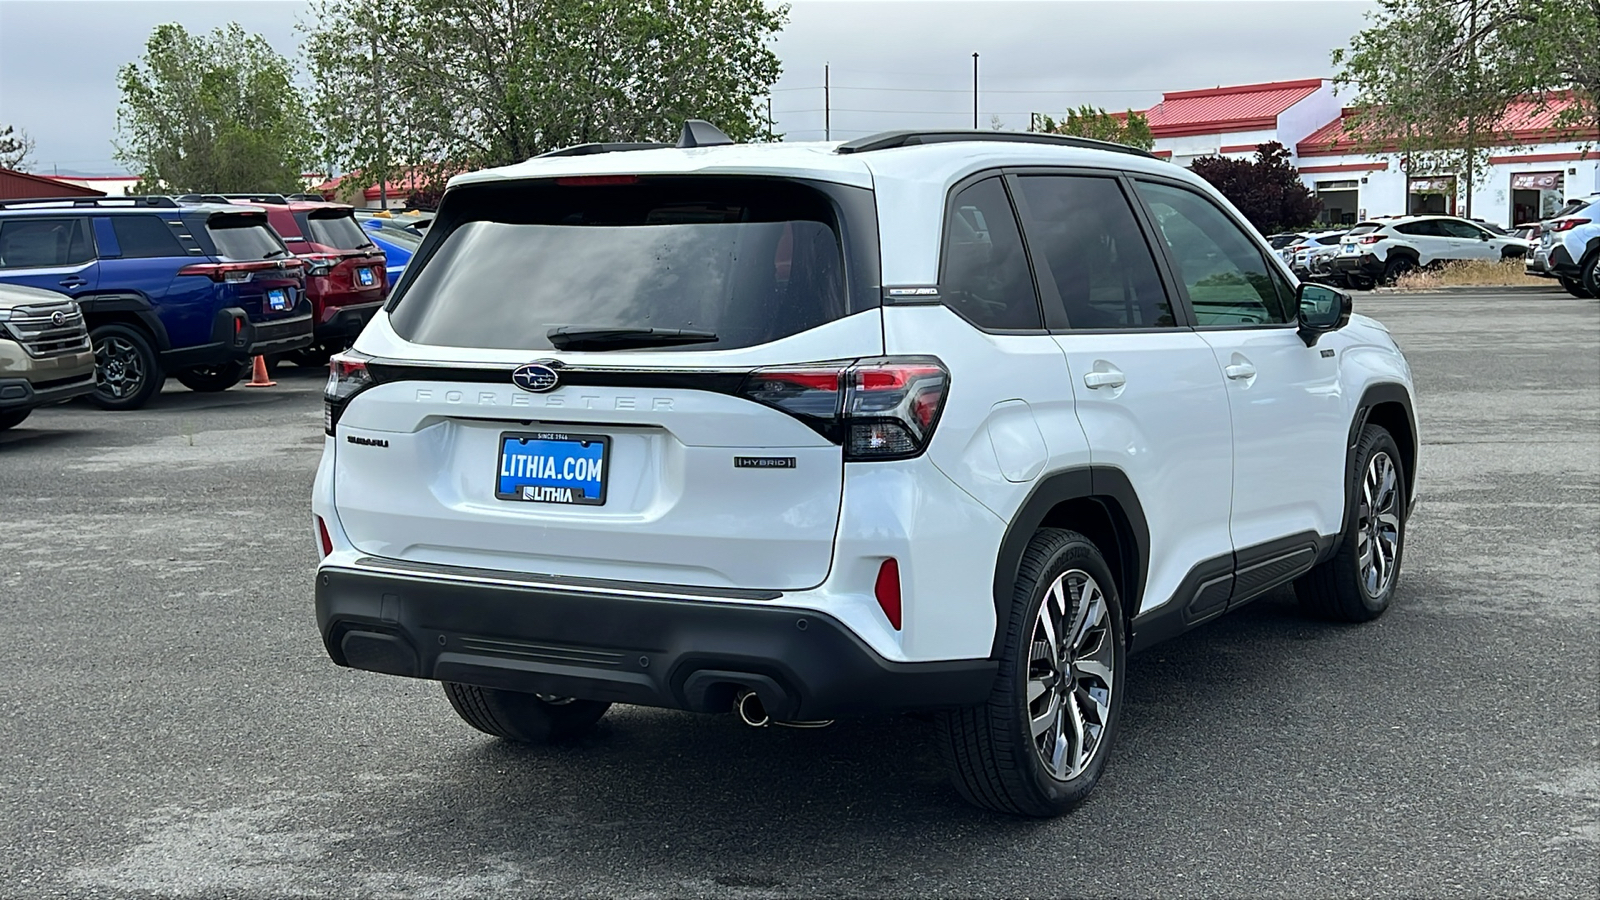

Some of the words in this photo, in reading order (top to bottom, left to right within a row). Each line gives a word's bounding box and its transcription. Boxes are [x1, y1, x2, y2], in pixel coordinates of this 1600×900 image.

[415, 388, 675, 412] FORESTER
[347, 435, 389, 447] SUBARU
[500, 453, 603, 482] LITHIA.COM
[534, 486, 573, 502] LITHIA
